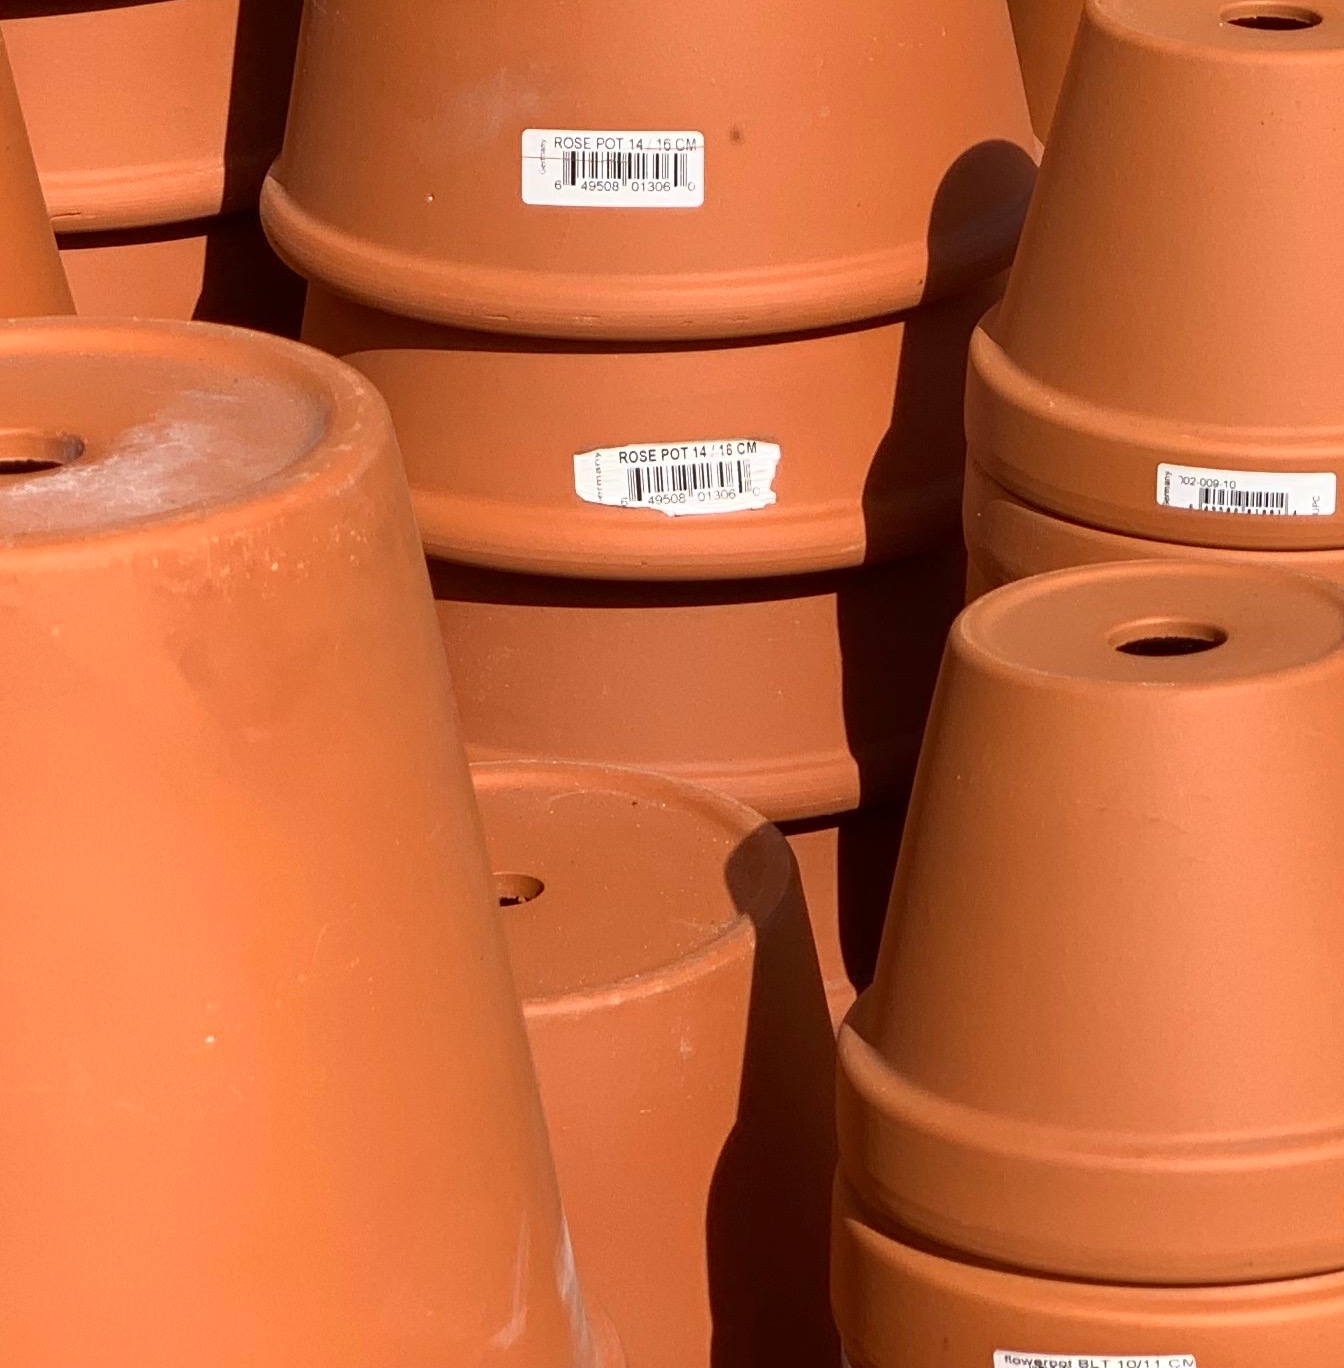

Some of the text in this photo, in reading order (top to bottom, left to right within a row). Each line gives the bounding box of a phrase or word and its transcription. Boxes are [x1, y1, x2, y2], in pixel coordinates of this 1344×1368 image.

[555, 137, 591, 150] ROSE
[596, 137, 624, 150] POT
[629, 138, 644, 151] 14
[657, 138, 671, 151] 16
[675, 138, 697, 151] CM
[555, 180, 696, 192] 6 49508 01306 0
[619, 449, 656, 464] ROSE
[661, 446, 689, 461] POT
[693, 445, 707, 459] 14
[719, 443, 733, 457] 16
[737, 441, 757, 455] CM
[594, 452, 602, 501] ermany
[648, 493, 686, 505] 49508
[698, 488, 737, 502] 01306
